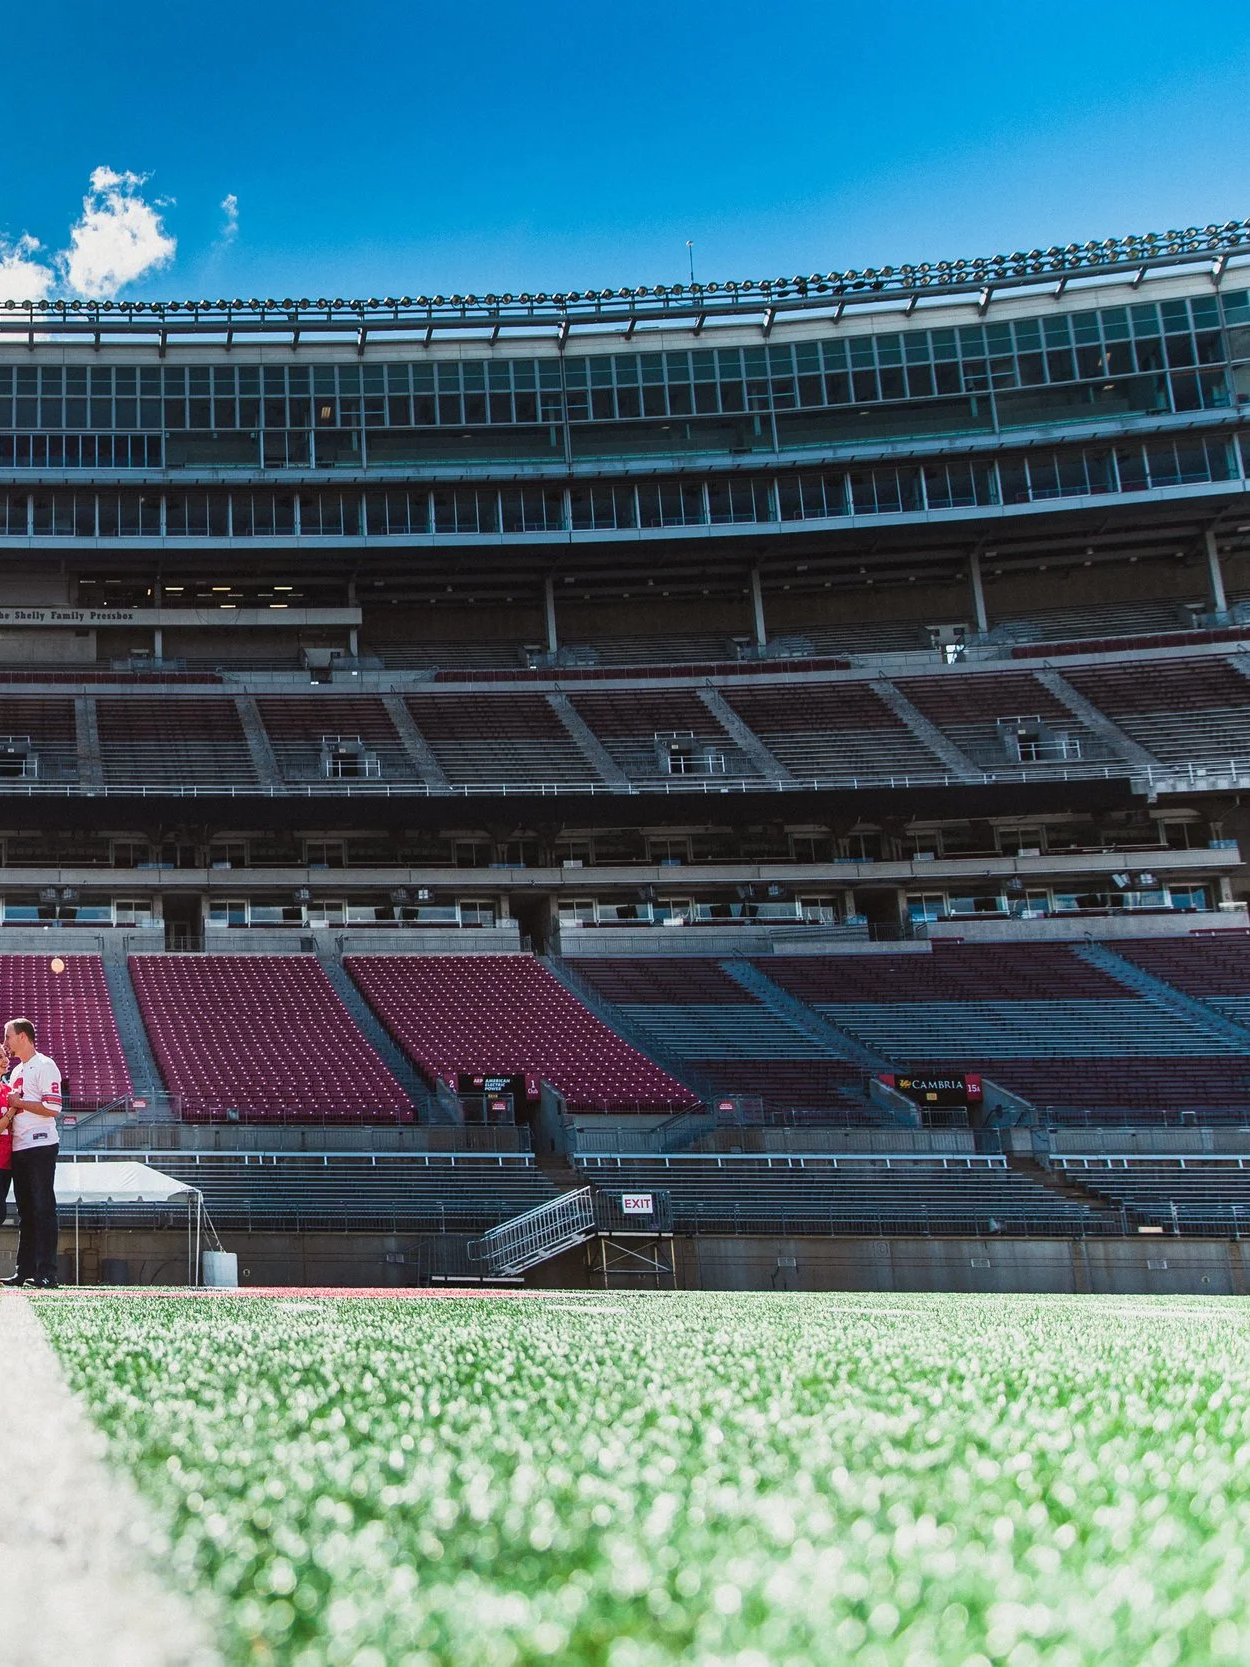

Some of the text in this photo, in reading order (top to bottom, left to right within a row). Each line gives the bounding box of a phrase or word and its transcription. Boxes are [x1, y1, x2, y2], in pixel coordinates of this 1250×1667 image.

[15, 611, 45, 621] Shelly
[51, 611, 84, 621] Family
[90, 611, 133, 620] Pressbox
[51, 1082, 59, 1093] 2
[449, 1079, 455, 1088] 2
[531, 1080, 535, 1088] 1
[912, 1080, 963, 1089] CAMBRIA
[625, 1199, 650, 1208] EXIT
